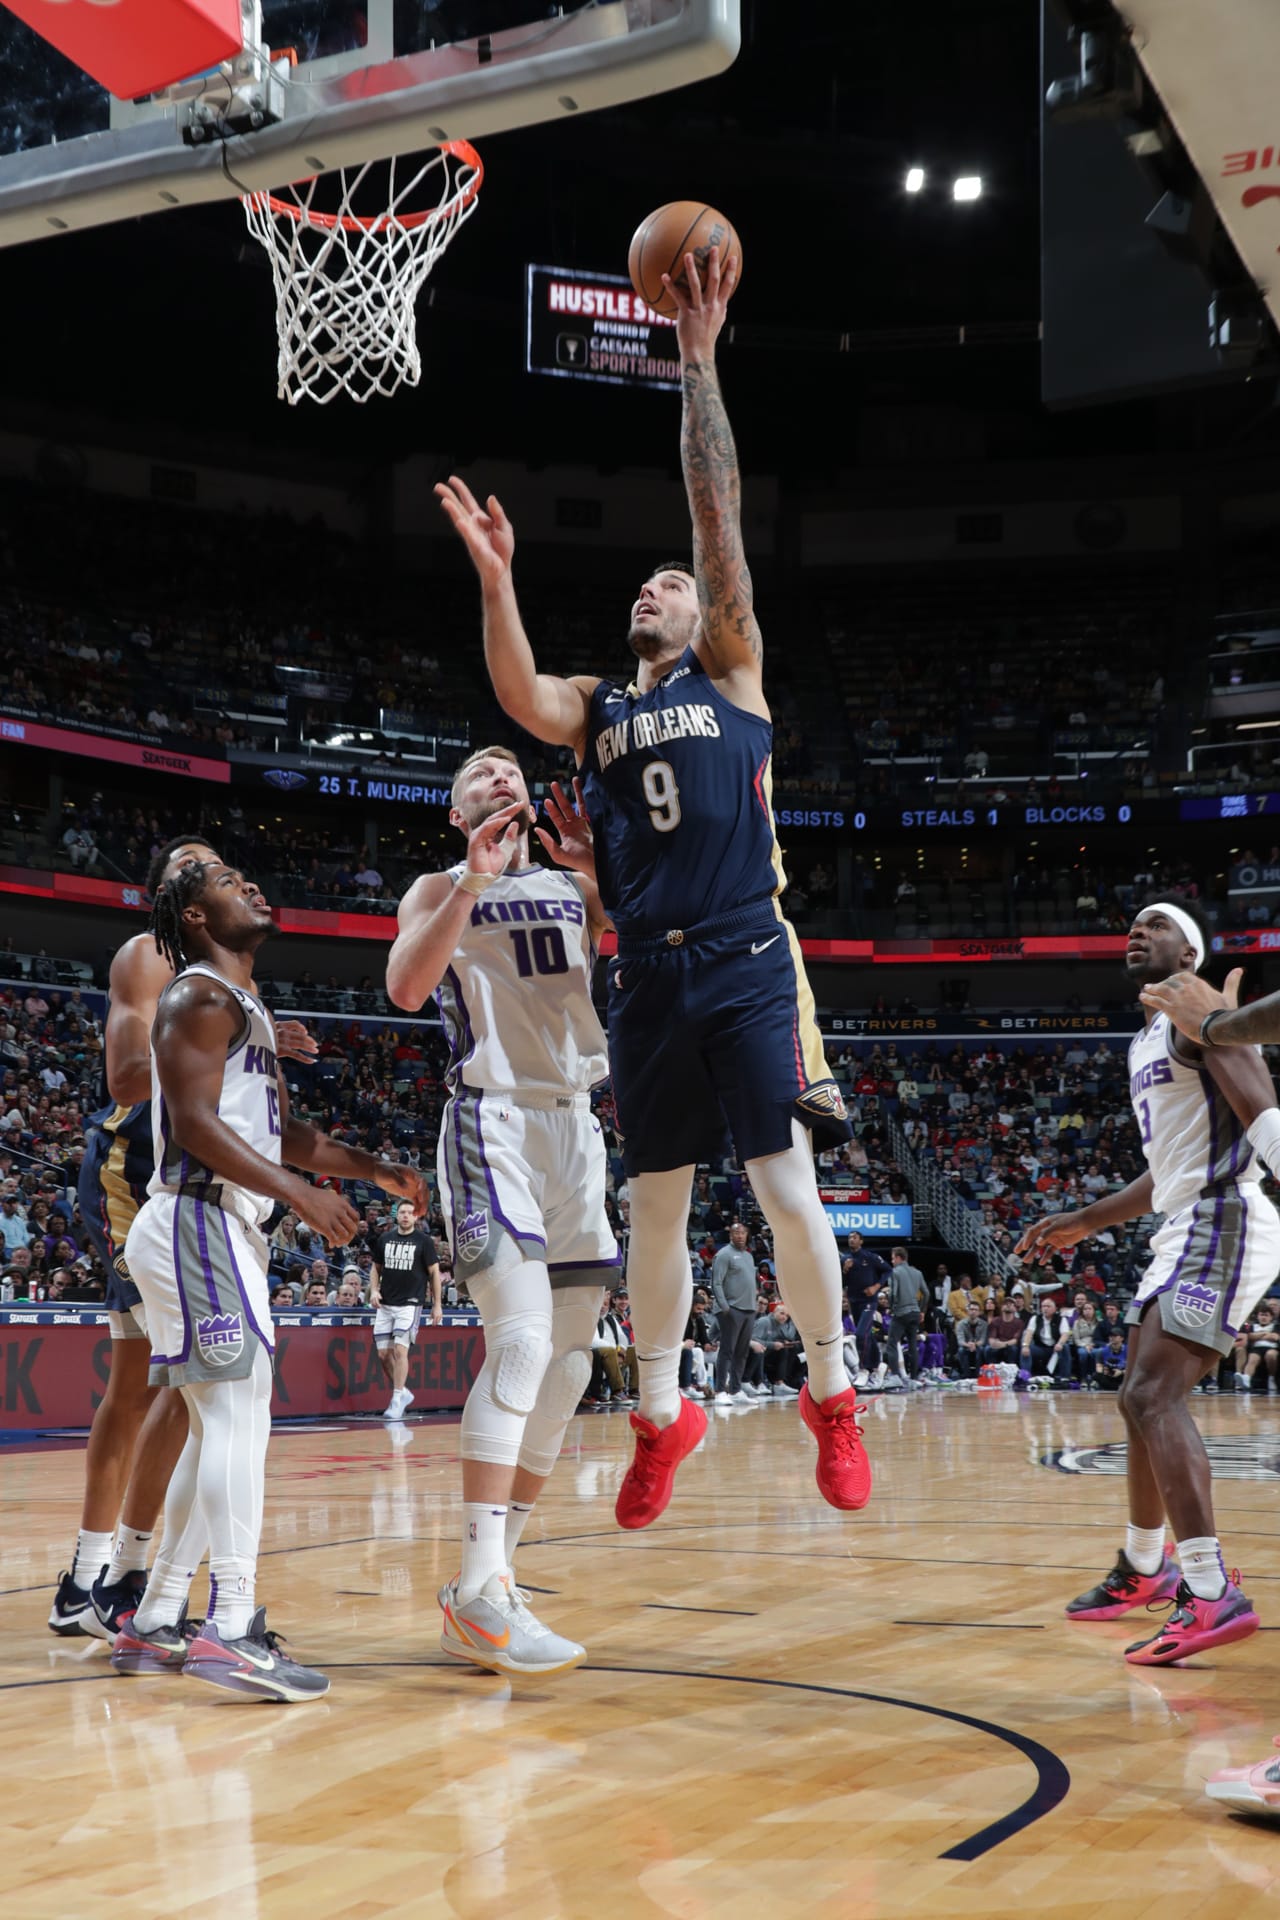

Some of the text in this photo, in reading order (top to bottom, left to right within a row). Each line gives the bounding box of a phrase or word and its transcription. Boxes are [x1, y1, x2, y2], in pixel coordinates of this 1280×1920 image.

[550, 283, 629, 320] HUSTLE
[594, 320, 650, 340] PRESENTED BY
[590, 336, 647, 356] CAESARS
[595, 703, 721, 773] NEW ORLEANS
[142, 751, 191, 773] SEATGEEK
[319, 776, 449, 807] 25 T. MURPHY
[642, 760, 682, 832] 9
[1256, 795, 1268, 813] 7
[854, 812, 867, 829] 0
[901, 809, 975, 827] STEALS
[987, 809, 998, 827] 1
[1025, 806, 1105, 824] BLOCKS
[1118, 805, 1131, 823] 0
[470, 899, 583, 928] KINGS
[509, 926, 569, 978] 10
[959, 944, 1024, 956] SEATGEEK
[832, 1019, 937, 1030] BETRIVERS
[1000, 1017, 1109, 1029] BETRIVERS
[266, 1085, 281, 1137] 15
[1139, 1098, 1152, 1145] 3
[826, 1212, 901, 1229] ANDUEL
[457, 1225, 488, 1248] SAC
[385, 1242, 417, 1260] BLACK
[1175, 1294, 1215, 1315] SAC
[199, 1330, 243, 1348] SAC
[326, 1335, 477, 1400] SEAGEEK
